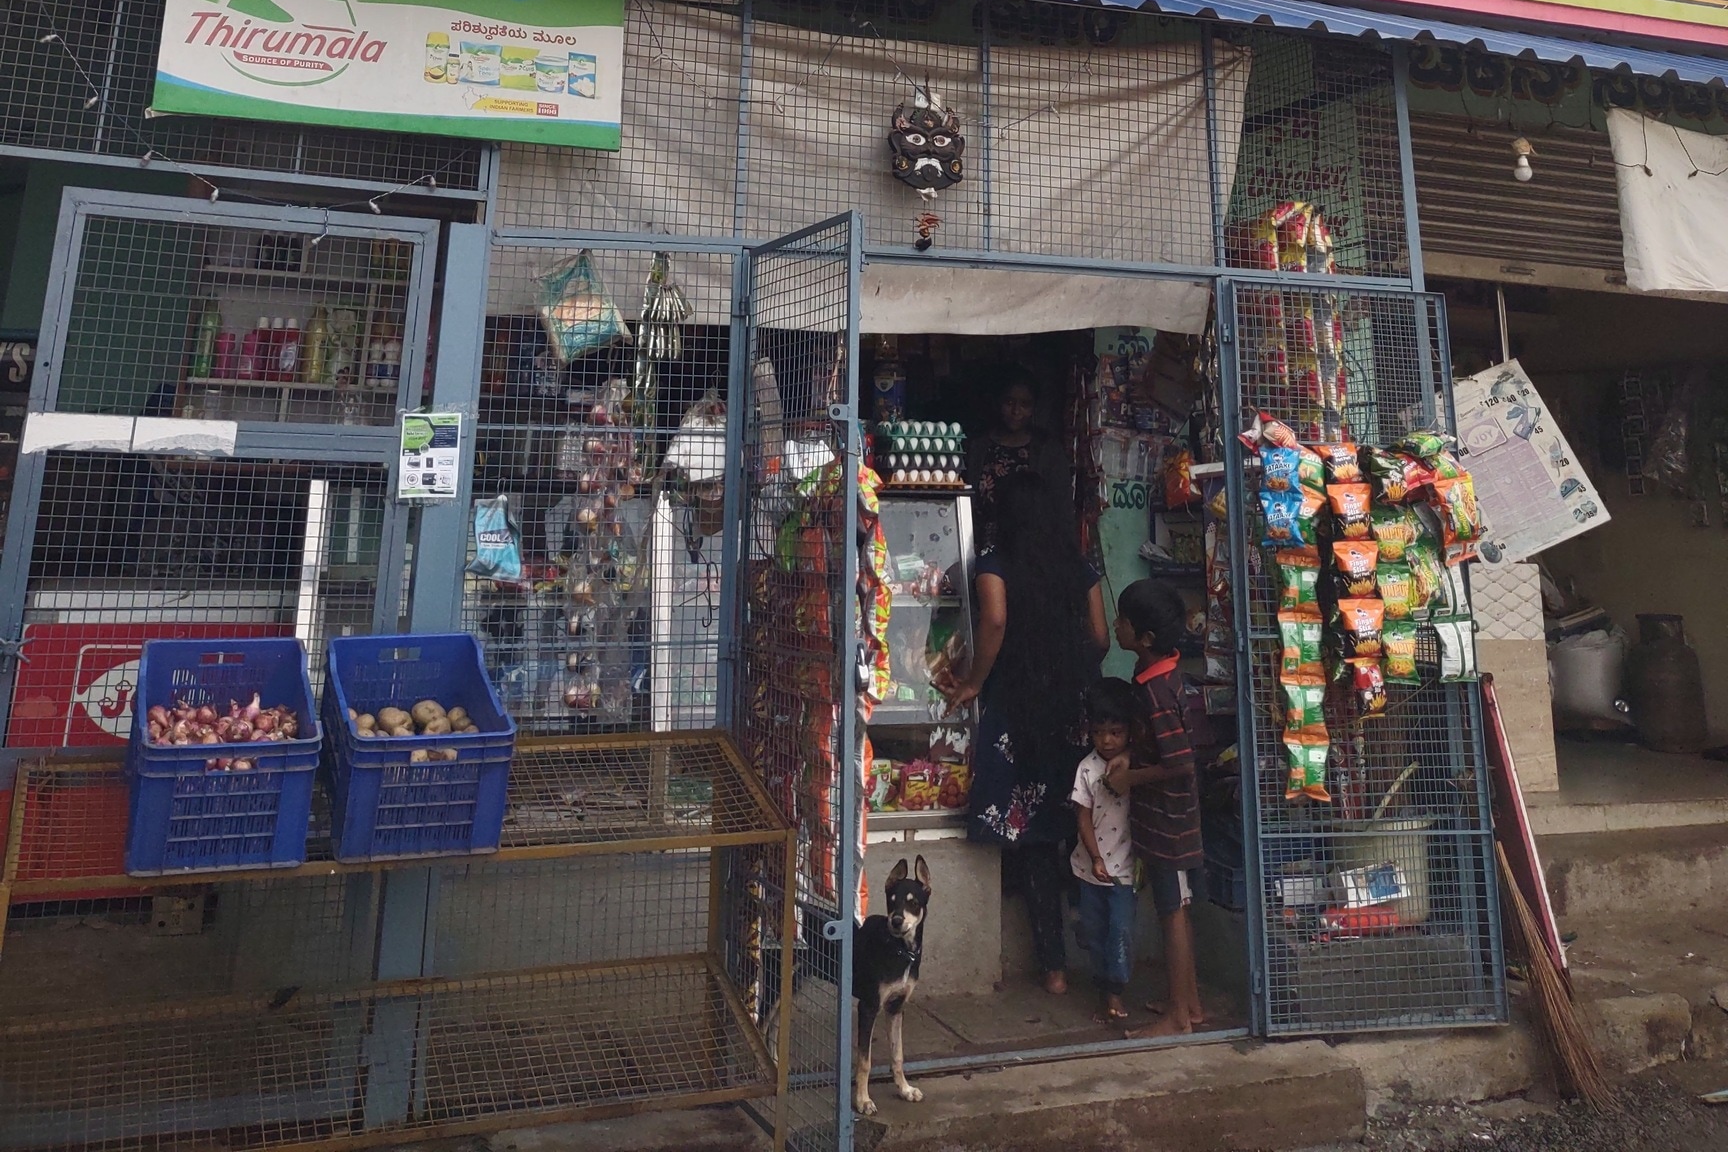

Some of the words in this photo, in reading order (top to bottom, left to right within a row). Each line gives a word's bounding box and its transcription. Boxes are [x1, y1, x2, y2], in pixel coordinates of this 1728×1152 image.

[184, 11, 388, 63] Thirumala
[1474, 430, 1494, 445] JOY
[480, 533, 501, 542] COOL
